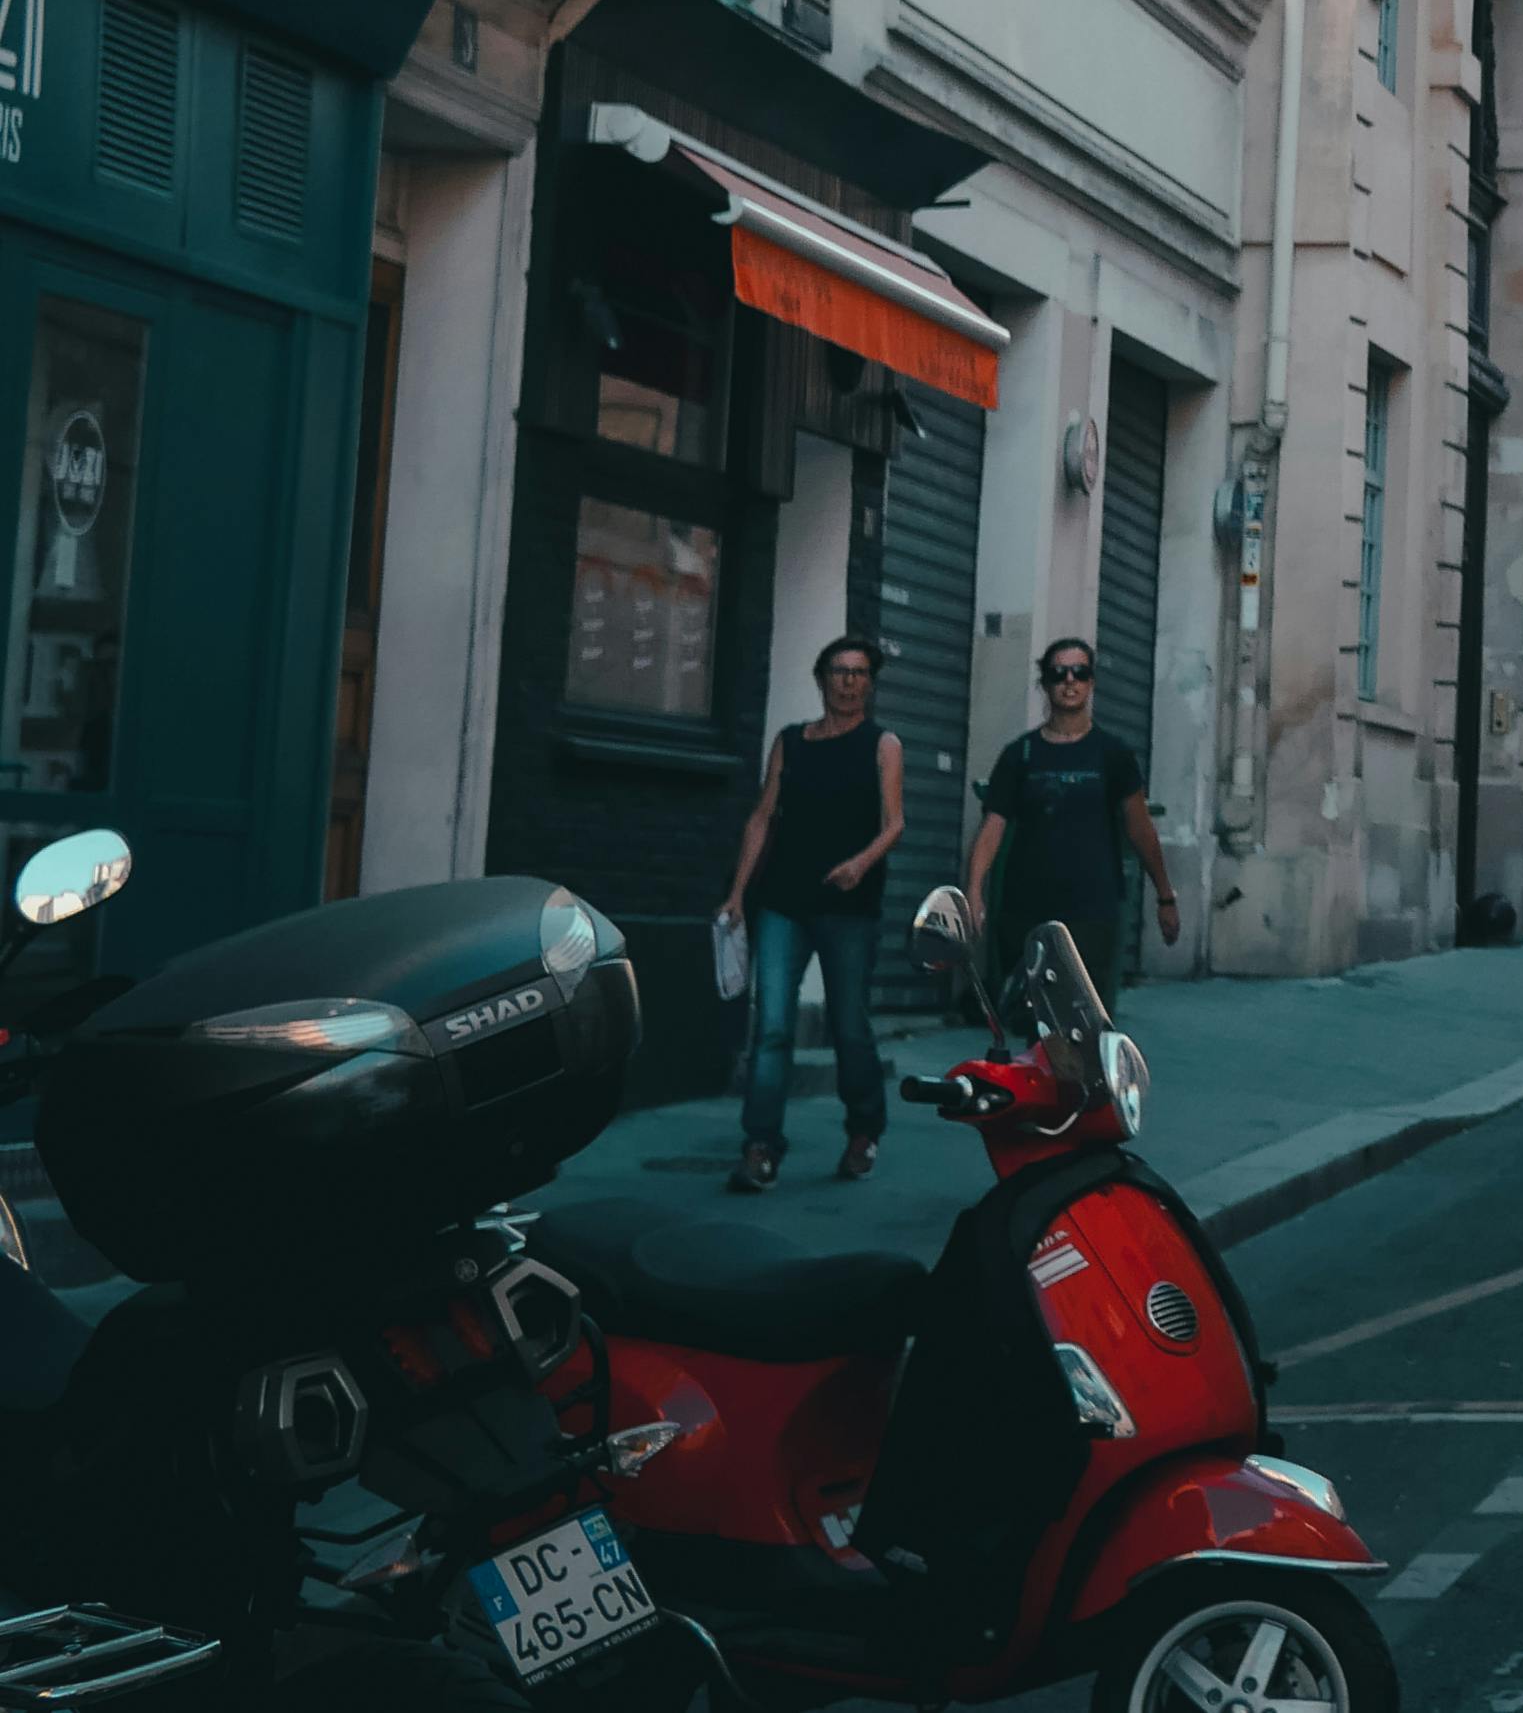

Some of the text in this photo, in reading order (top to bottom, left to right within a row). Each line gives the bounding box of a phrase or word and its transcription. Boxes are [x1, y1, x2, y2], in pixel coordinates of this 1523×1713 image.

[445, 988, 544, 1041] SHAD
[600, 1539, 620, 1564] 47
[493, 1596, 504, 1613] F
[514, 1568, 651, 1663] 465-CN
